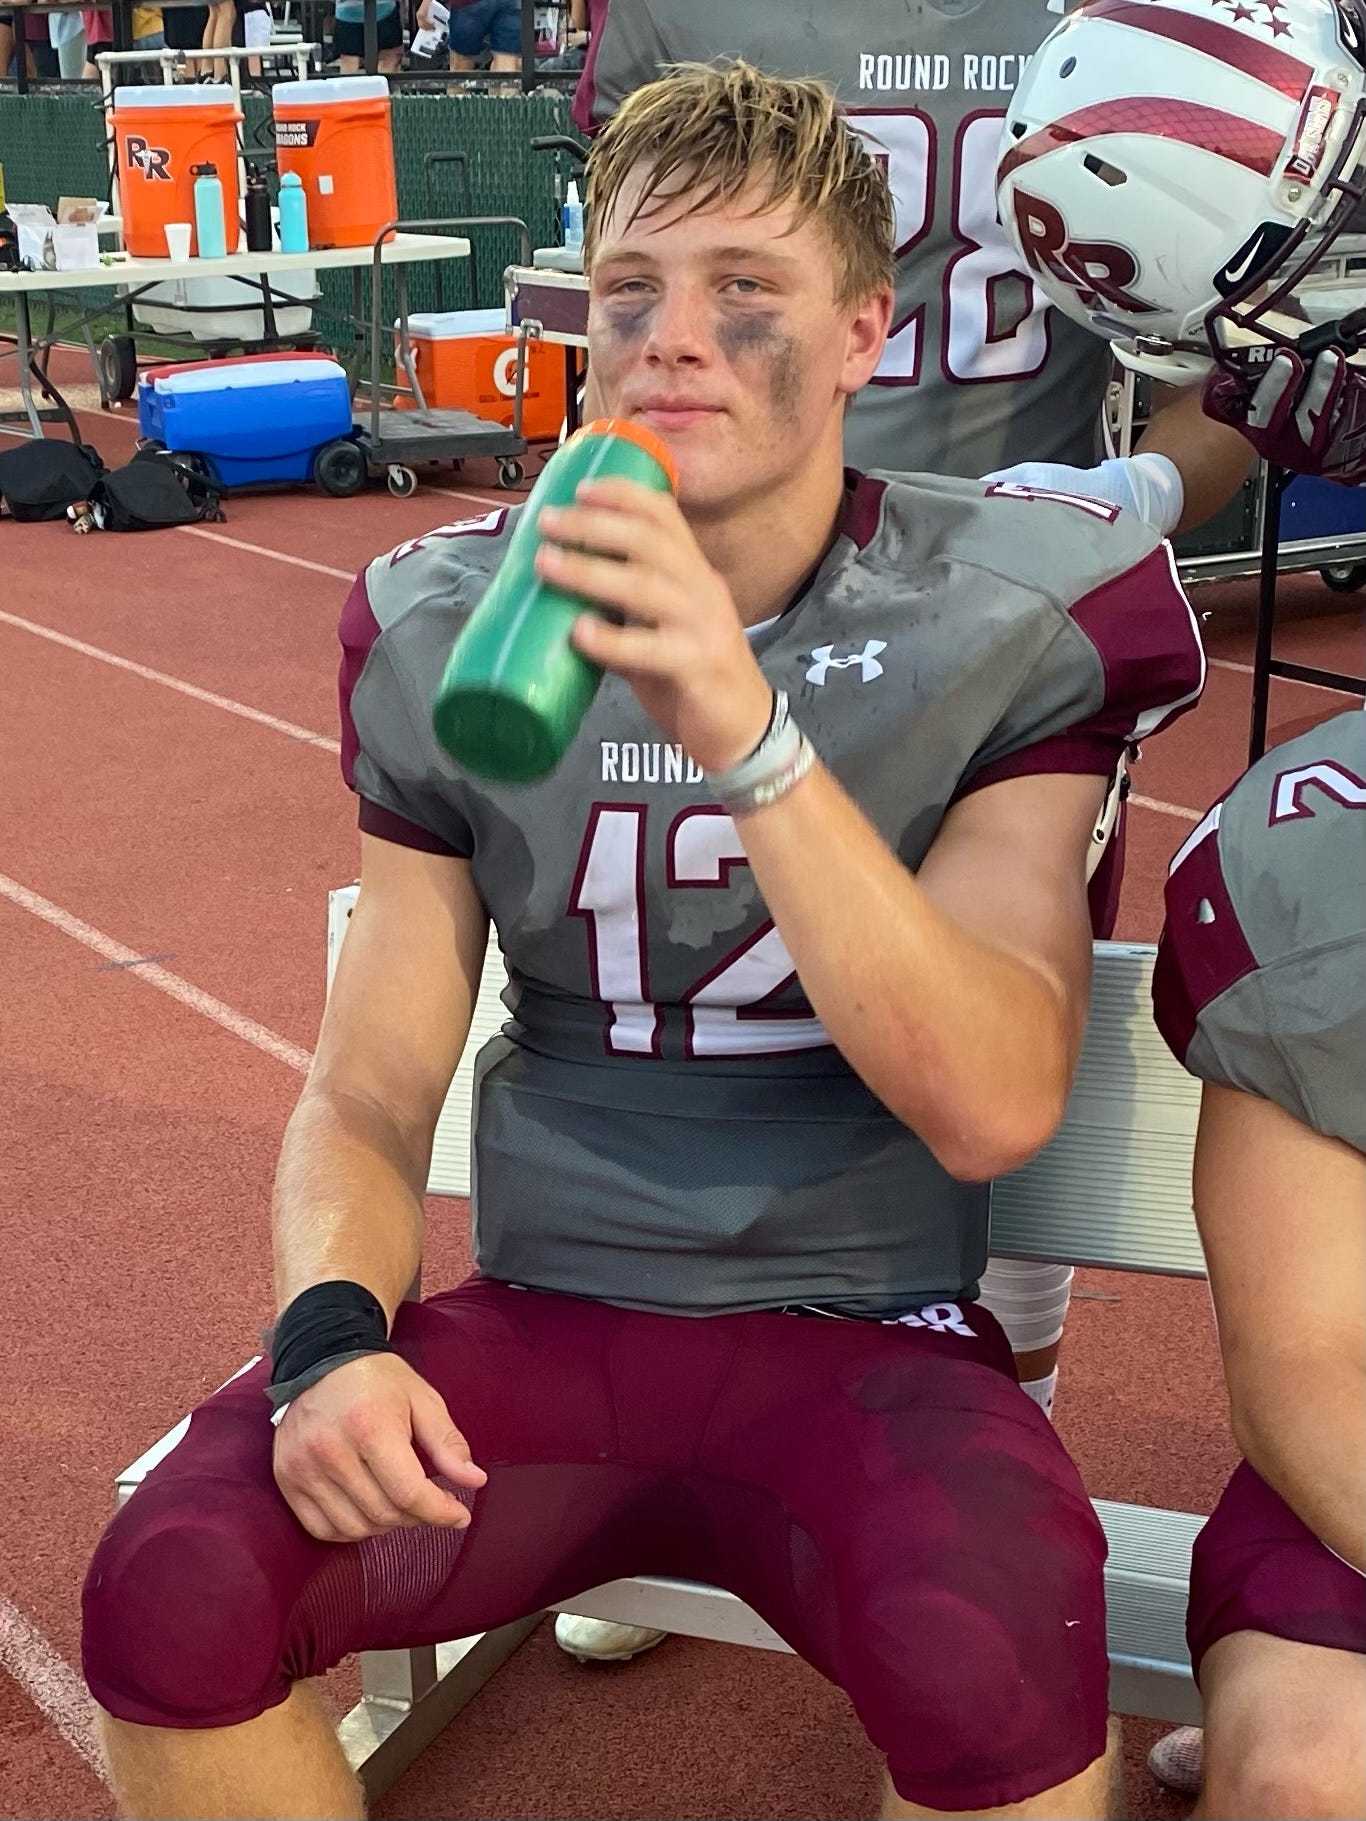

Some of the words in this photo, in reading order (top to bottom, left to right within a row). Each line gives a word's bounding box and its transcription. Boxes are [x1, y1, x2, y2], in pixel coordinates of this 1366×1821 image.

[859, 53, 950, 91] ROUND
[125, 134, 177, 182] RR
[1012, 182, 1174, 316] RR
[493, 346, 530, 397] G
[600, 741, 704, 784] ROUND
[566, 801, 836, 1062] 12
